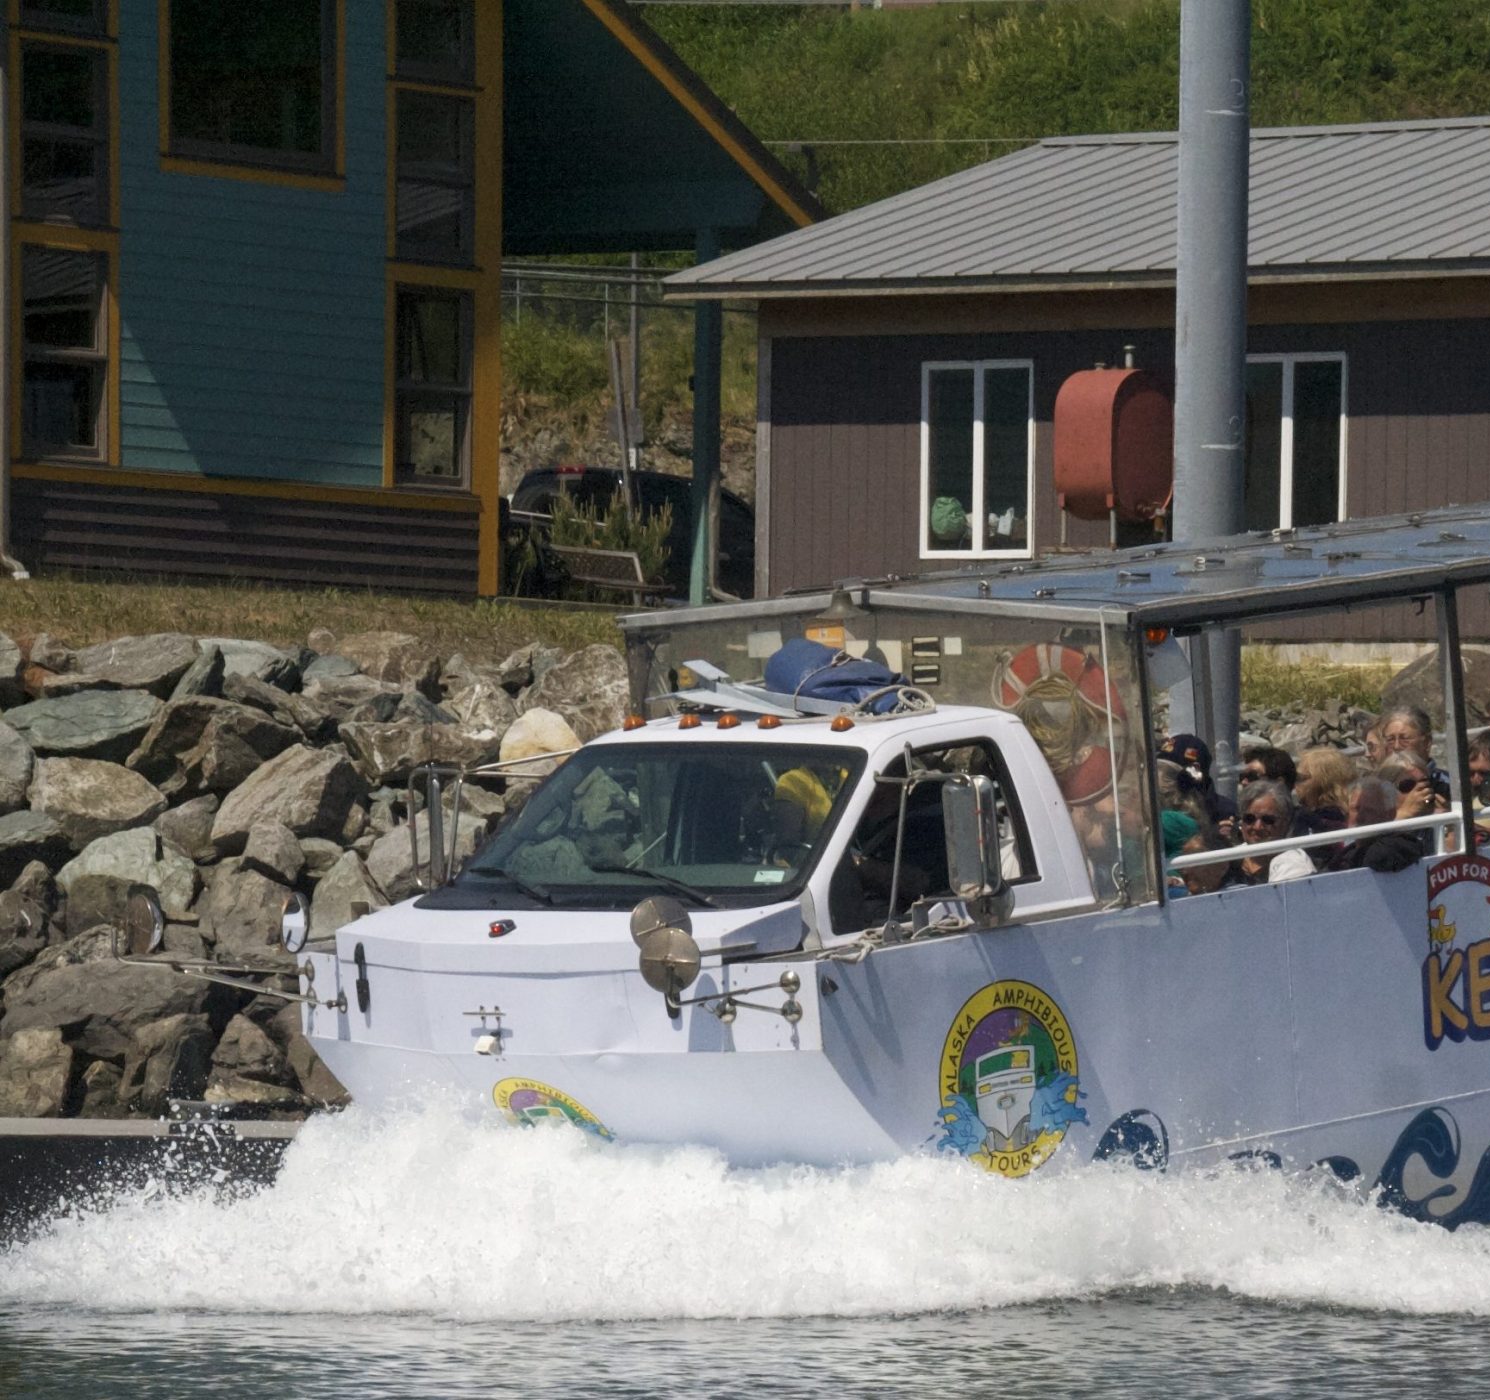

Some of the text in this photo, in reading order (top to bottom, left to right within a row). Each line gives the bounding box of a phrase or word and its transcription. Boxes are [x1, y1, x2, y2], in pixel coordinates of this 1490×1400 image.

[1430, 866, 1458, 888] FUN
[1462, 863, 1488, 881] FOR
[946, 988, 1073, 1094] ALASKA AMPHIBIOUS
[988, 1146, 1041, 1172] TOURS
